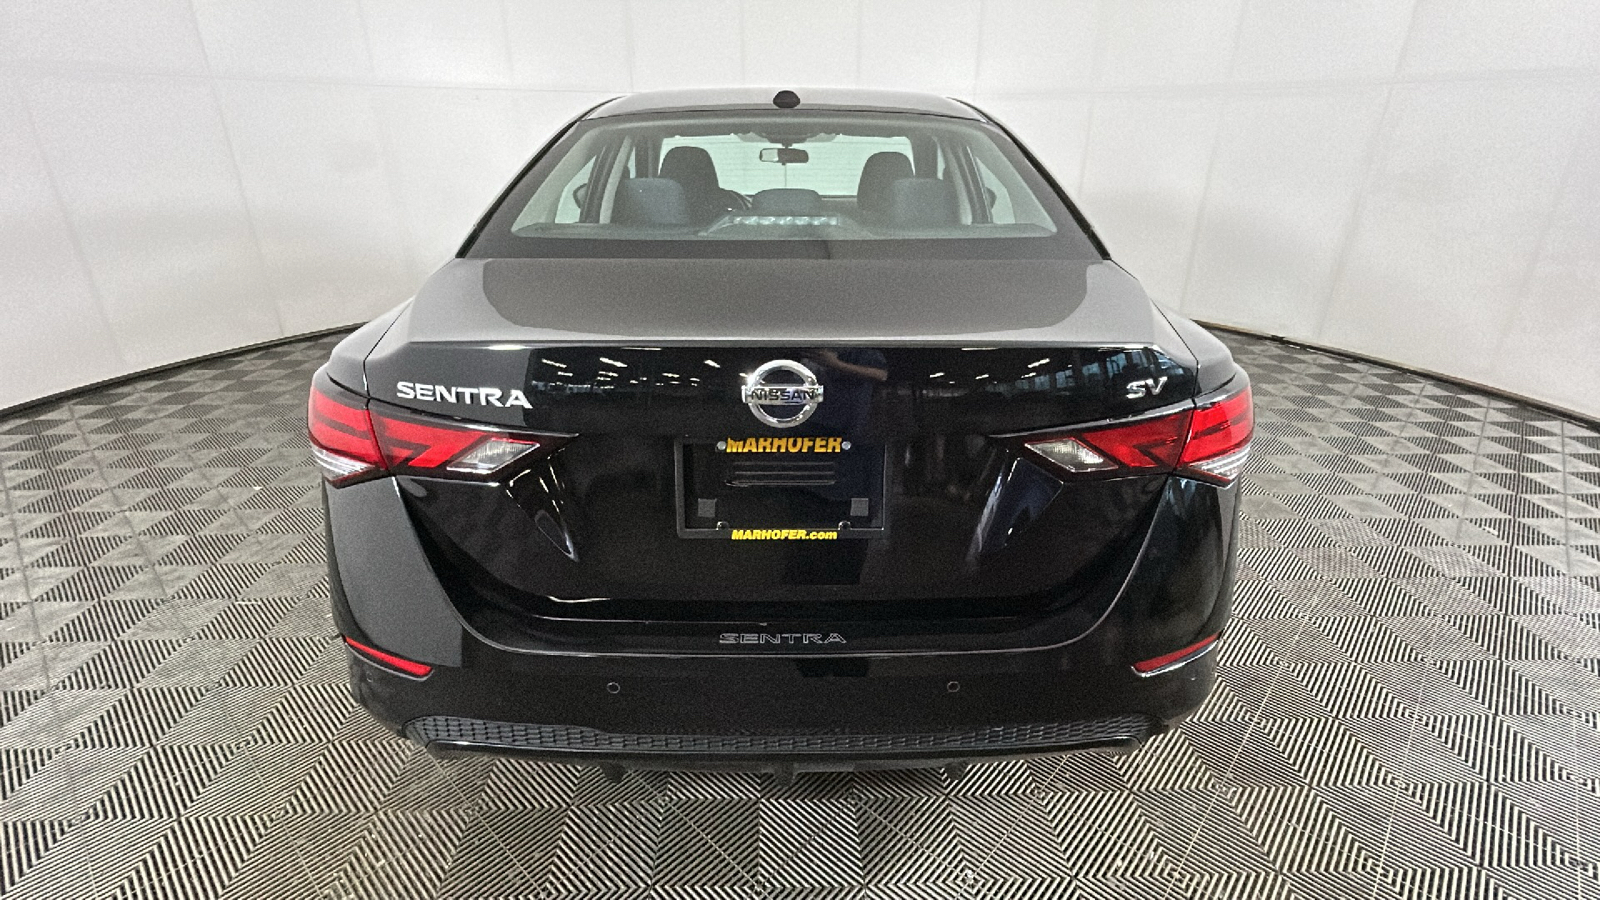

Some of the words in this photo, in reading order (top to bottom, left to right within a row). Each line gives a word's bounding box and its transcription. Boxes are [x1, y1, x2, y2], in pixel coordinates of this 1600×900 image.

[397, 381, 533, 409] SENTRA
[751, 387, 815, 401] NISSAN
[1126, 376, 1168, 399] SV
[726, 437, 843, 453] MARHOFER
[731, 529, 838, 540] MARHOFER.com
[719, 633, 847, 644] SENTRA
